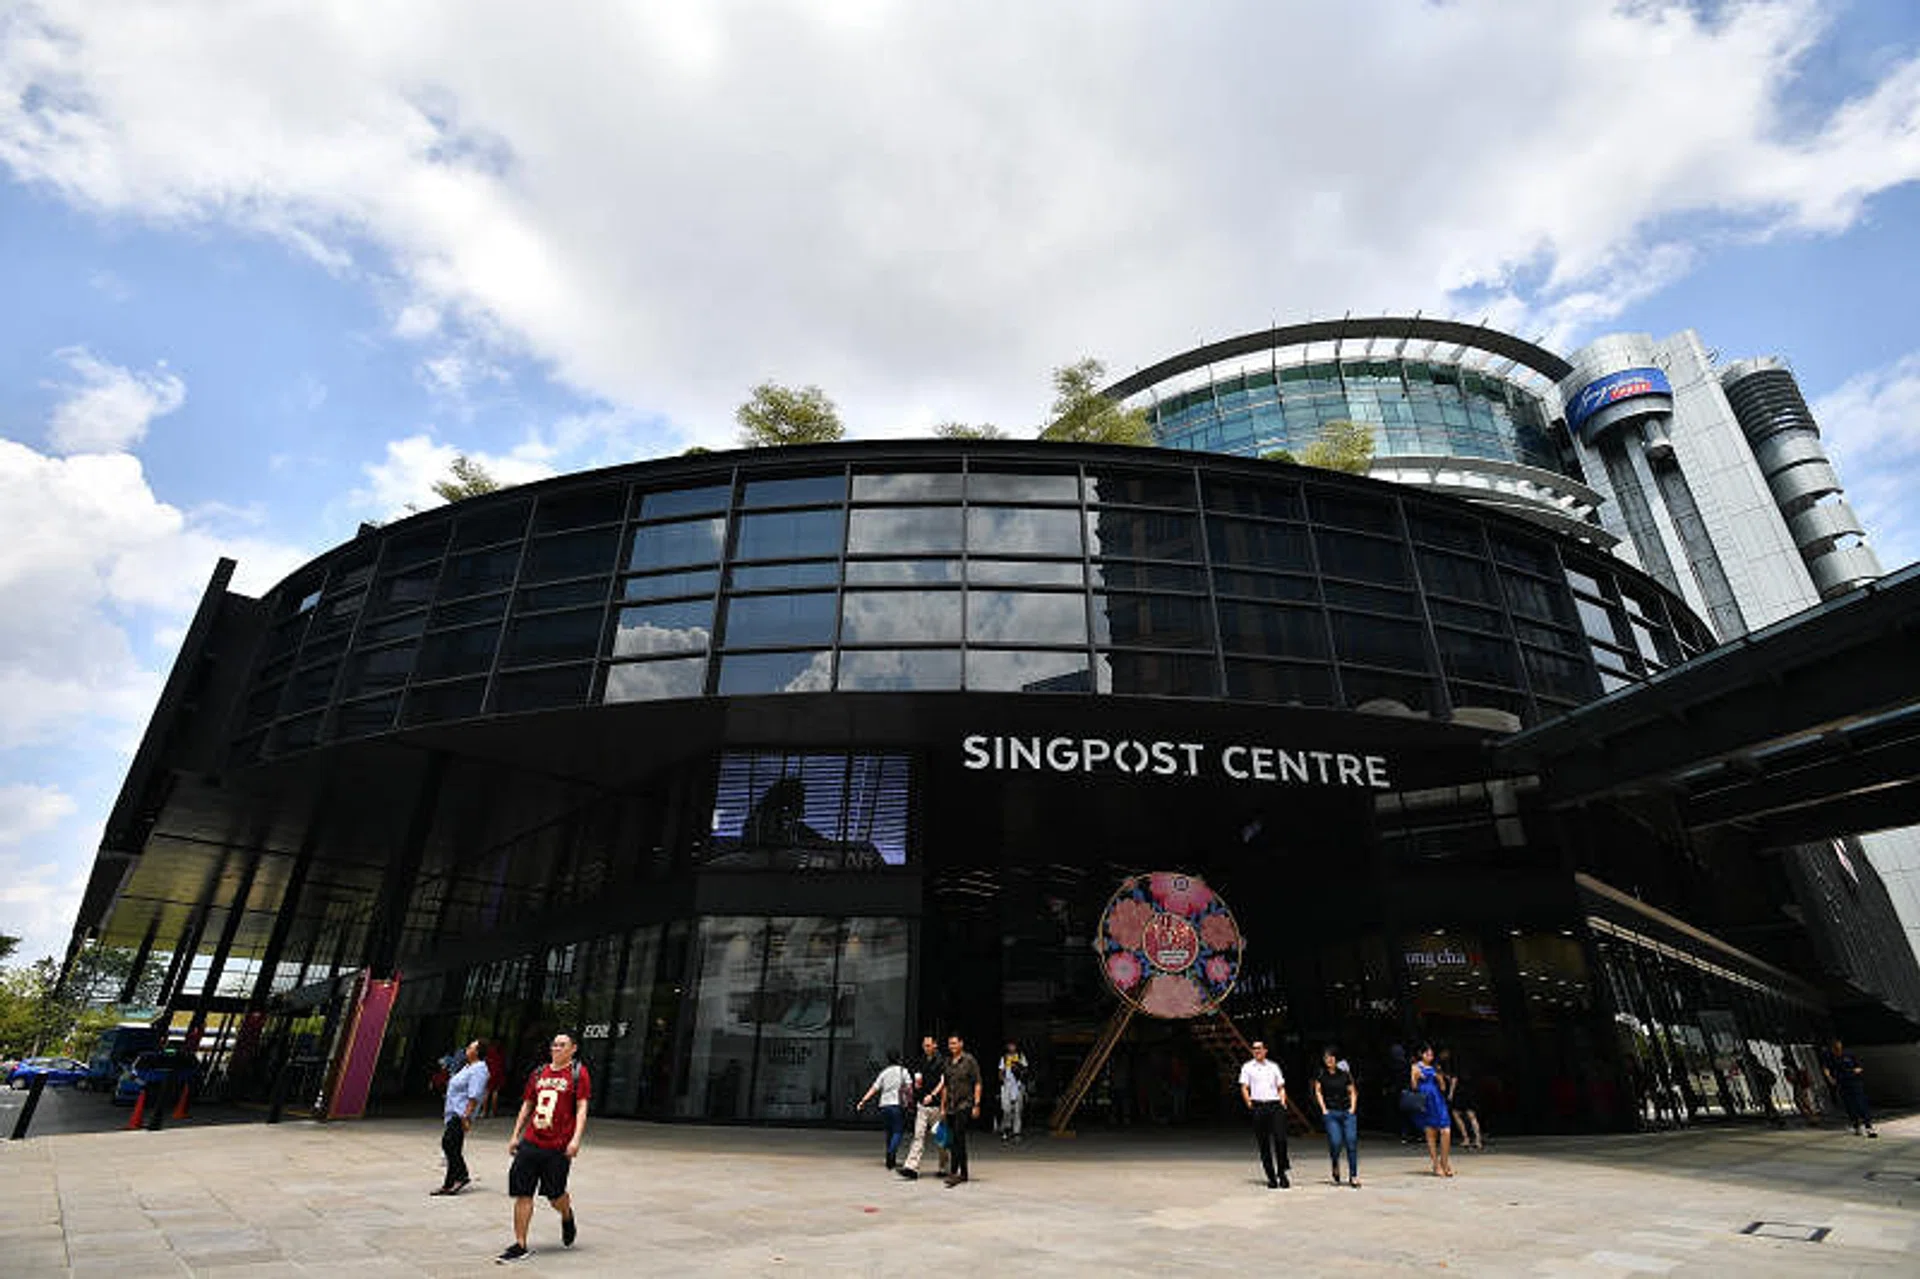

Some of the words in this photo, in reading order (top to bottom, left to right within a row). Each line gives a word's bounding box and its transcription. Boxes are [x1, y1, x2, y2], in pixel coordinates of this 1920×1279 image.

[963, 735, 1205, 777] SINGPOST
[1222, 746, 1391, 788] CENTRE
[1437, 948, 1466, 964] cha
[532, 1089, 559, 1130] 9
